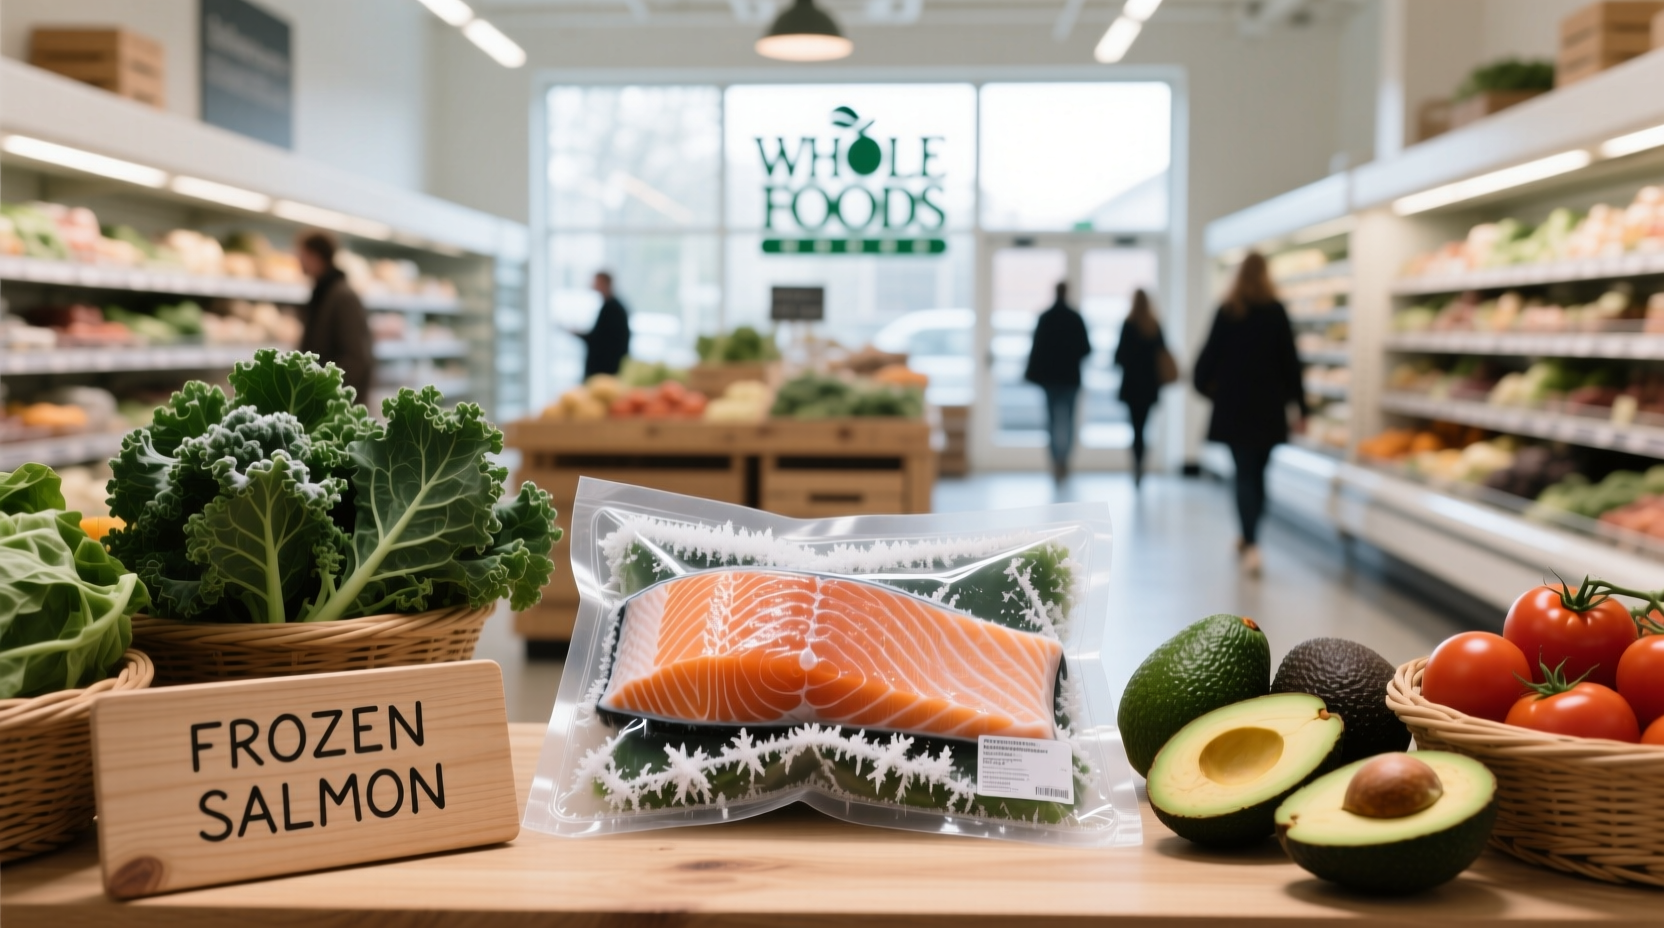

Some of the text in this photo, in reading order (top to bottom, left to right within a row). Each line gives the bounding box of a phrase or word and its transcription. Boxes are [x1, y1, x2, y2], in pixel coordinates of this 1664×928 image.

[754, 135, 947, 177] WHOLE
[763, 185, 946, 231] FOODS
[190, 700, 425, 773] FROZEN
[199, 762, 446, 842] SALMON
